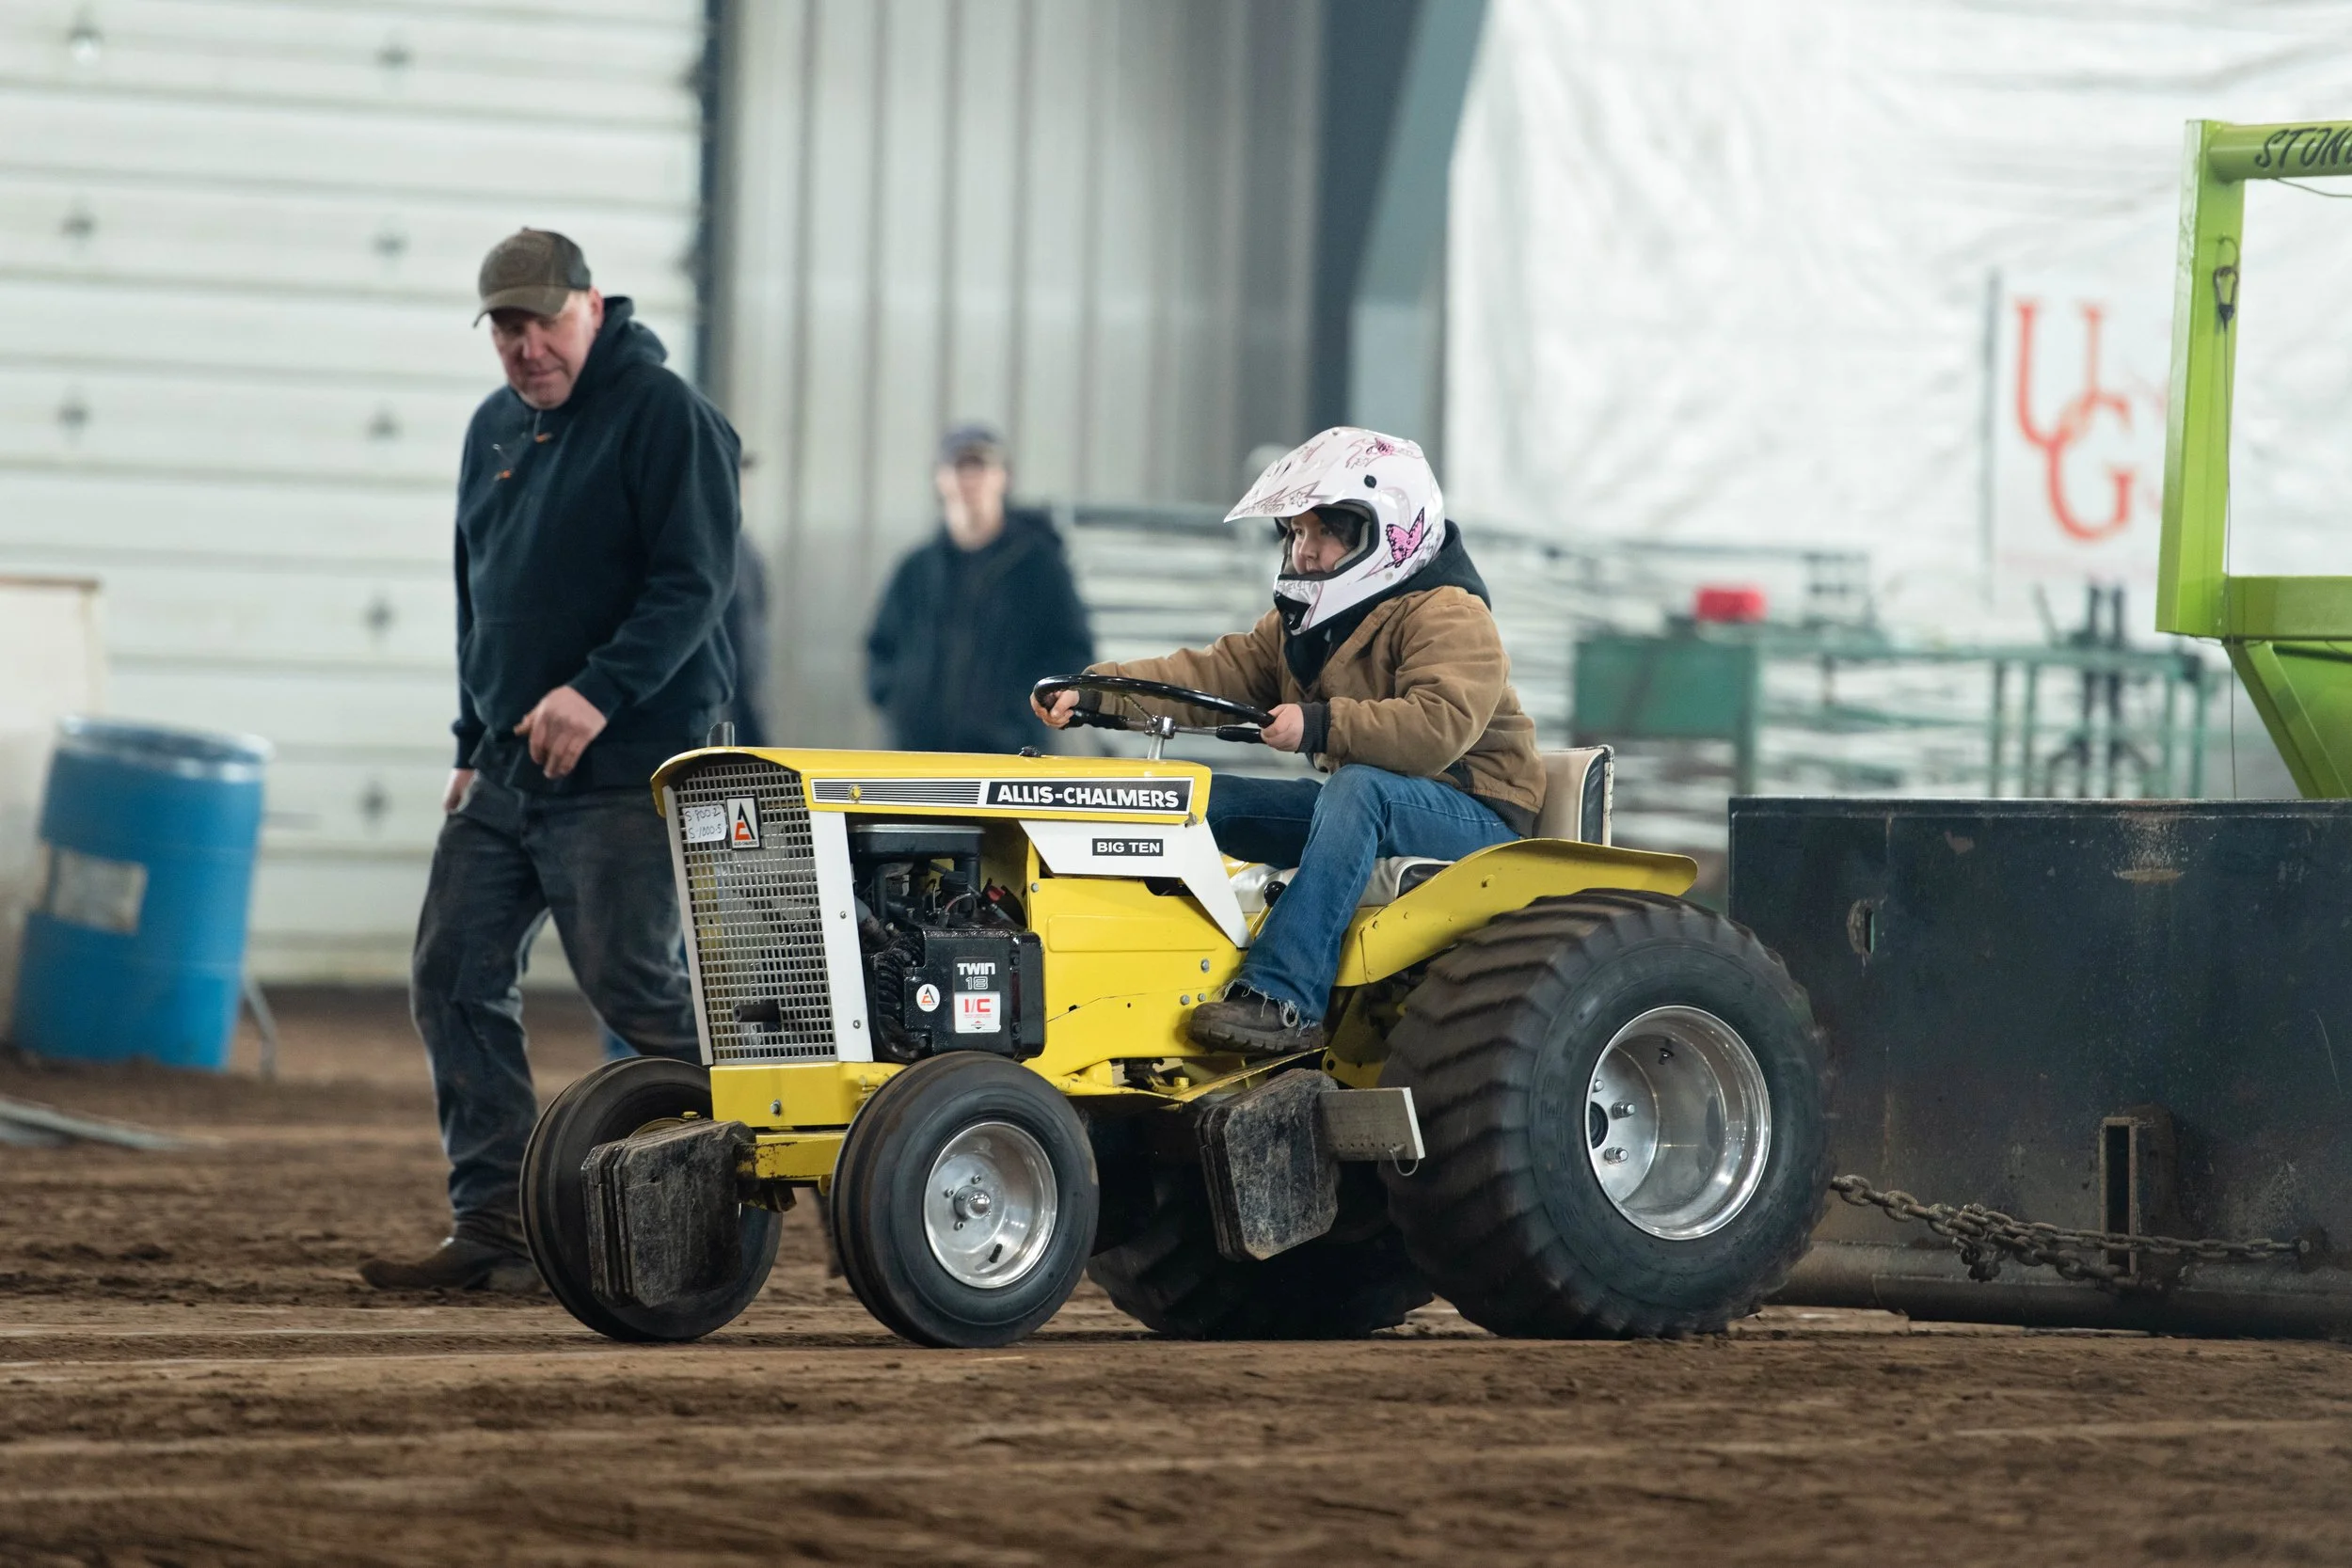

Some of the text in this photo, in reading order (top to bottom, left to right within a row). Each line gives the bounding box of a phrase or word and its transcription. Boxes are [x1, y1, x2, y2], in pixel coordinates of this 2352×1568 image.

[996, 784, 1180, 808] ALLIS-CHALMERS
[1096, 841, 1161, 853] BIG TEN
[957, 962, 996, 975] TWIN
[965, 975, 989, 990] 18
[964, 998, 991, 1013] I/C
